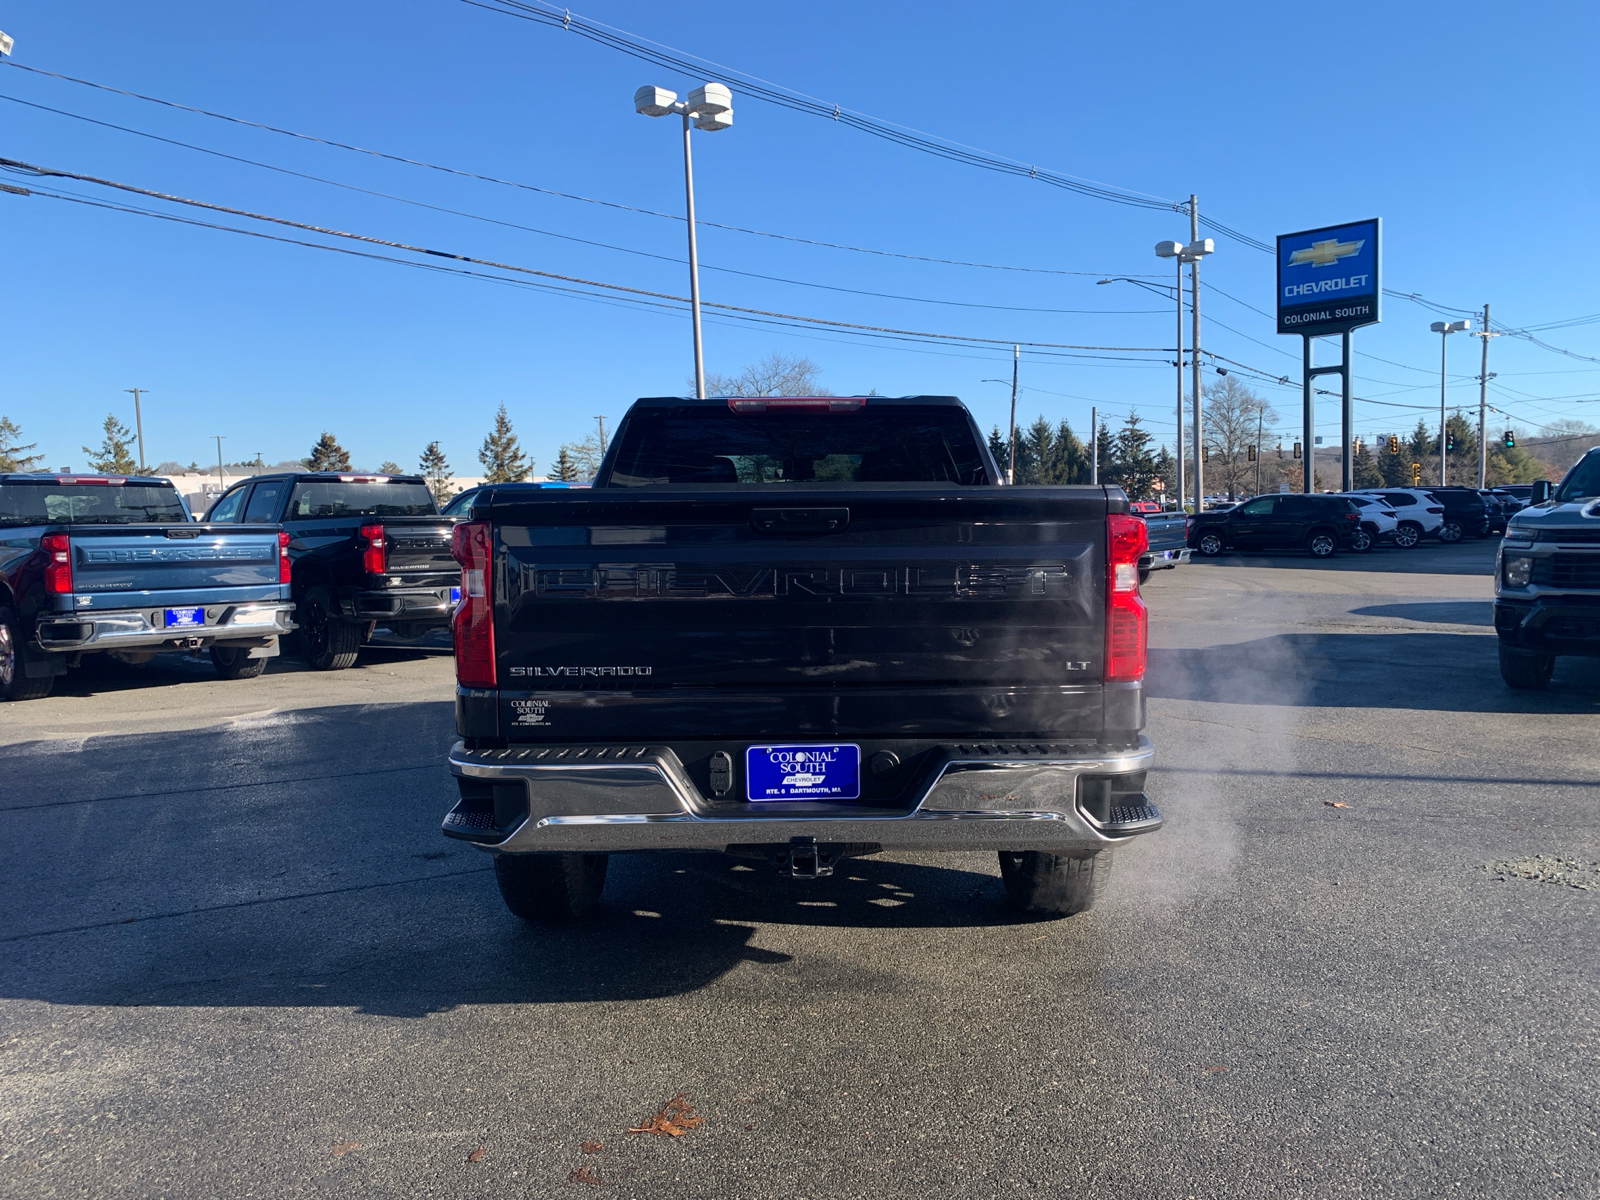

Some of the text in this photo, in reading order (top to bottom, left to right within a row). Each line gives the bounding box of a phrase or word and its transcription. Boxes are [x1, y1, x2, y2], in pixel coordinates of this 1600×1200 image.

[1284, 274, 1368, 297] CHEVROLET
[1284, 305, 1369, 324] COLONIAL SOUTH
[87, 548, 271, 562] CHEVROLET
[1066, 661, 1091, 670] LT
[510, 666, 652, 677] SILVERADO
[770, 752, 836, 763] COLONIAL
[780, 762, 826, 773] SOUTH
